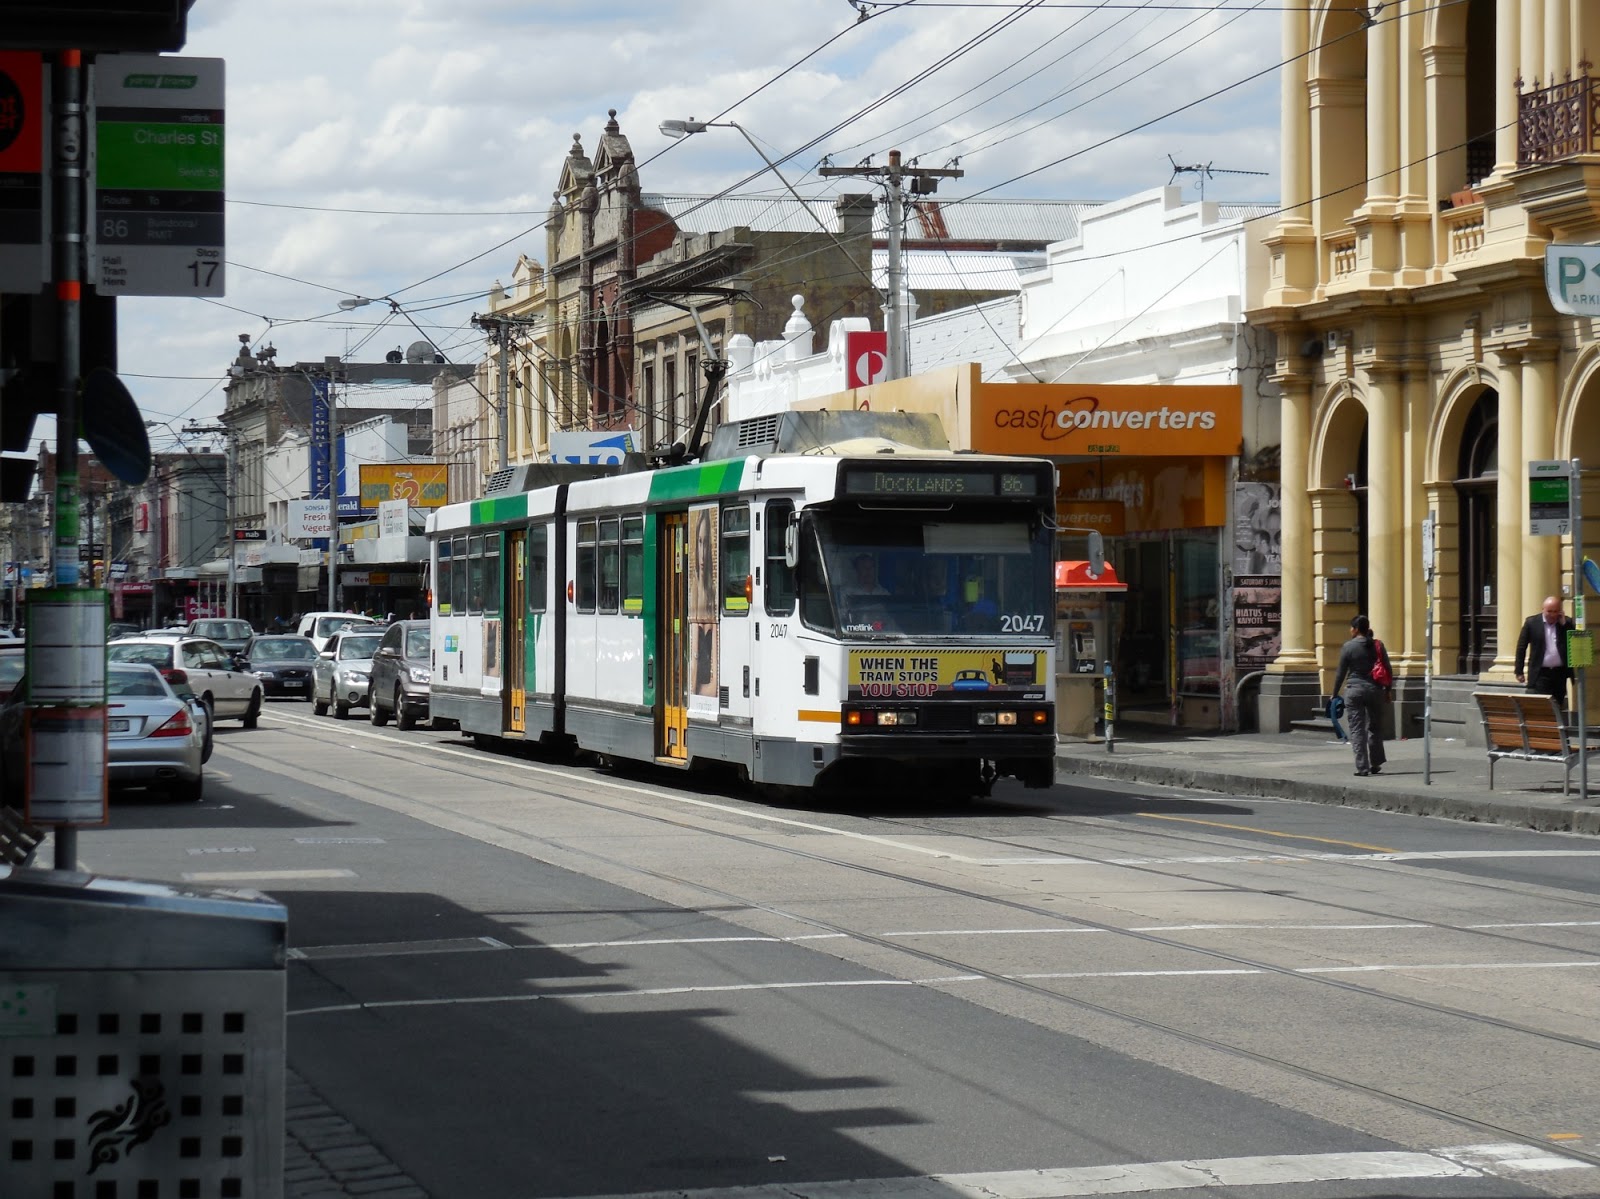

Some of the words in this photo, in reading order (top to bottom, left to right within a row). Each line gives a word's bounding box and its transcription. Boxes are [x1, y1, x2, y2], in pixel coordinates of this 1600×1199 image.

[134, 130, 196, 145] Charles
[201, 130, 219, 145] St
[149, 196, 161, 205] To
[103, 219, 129, 238] 86
[196, 249, 219, 257] Stop
[103, 256, 121, 264] Hail
[102, 267, 127, 275] Tram
[187, 261, 219, 287] 17
[103, 277, 126, 286] Here
[362, 483, 389, 501] SUPER
[423, 482, 446, 500] SHOP
[337, 501, 358, 511] erald
[304, 513, 327, 521] Fresh
[302, 525, 331, 534] Vegeta
[1558, 524, 1568, 534] 17
[1235, 608, 1263, 618] HIATUS
[846, 624, 874, 632] metlink
[1000, 615, 1044, 632] 2047
[771, 623, 788, 639] 2047
[860, 658, 905, 670] WHEN
[910, 658, 938, 670] THE
[860, 671, 894, 681] TRAM
[899, 671, 938, 681] STOPS
[860, 683, 892, 696] YOU
[897, 683, 938, 696] STOP
